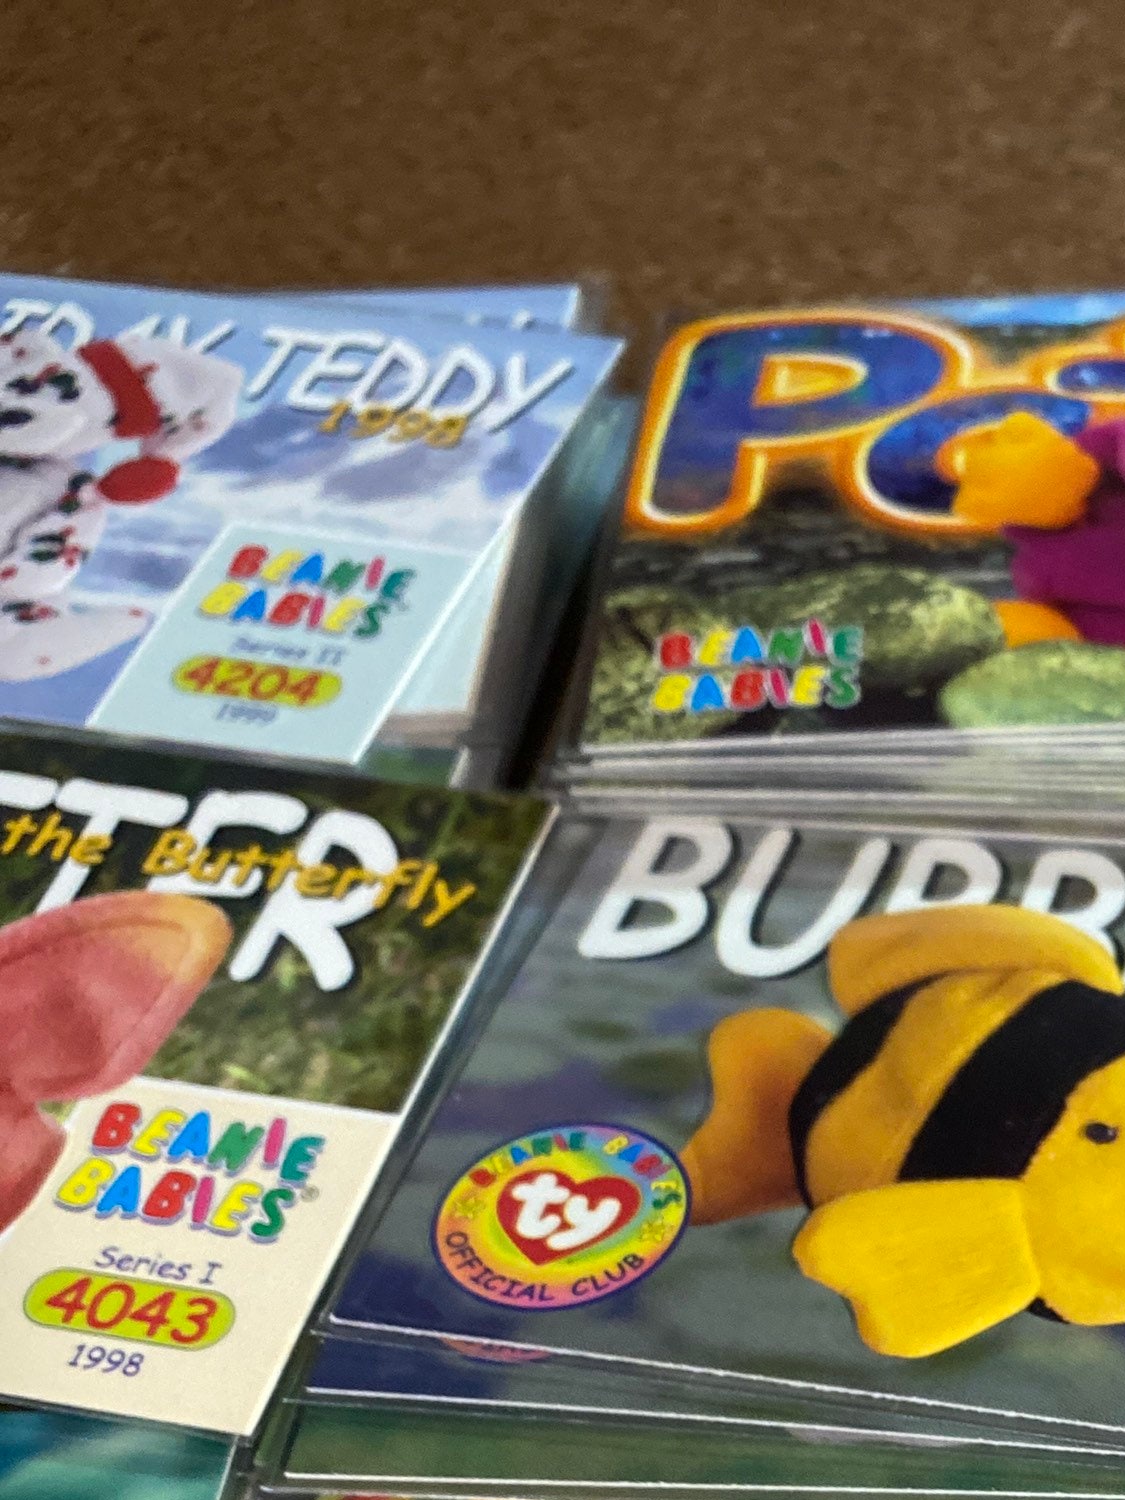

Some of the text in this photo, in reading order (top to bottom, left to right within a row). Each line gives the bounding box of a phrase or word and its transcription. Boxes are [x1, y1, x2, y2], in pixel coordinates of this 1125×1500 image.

[247, 328, 574, 432] TEDDY
[312, 402, 468, 448] 1998
[227, 543, 416, 600] BEANIE
[198, 580, 390, 638] BABIES
[655, 617, 865, 672] BEANIE
[182, 655, 322, 706] 4204
[650, 664, 862, 715] BABIES
[0, 772, 400, 992] TER
[2, 811, 477, 928] the Butterfly
[92, 1101, 326, 1188] BEANIE
[54, 1156, 296, 1244] BABIES
[511, 1172, 622, 1251] ty
[95, 1246, 223, 1286] Series I
[445, 1230, 646, 1301] OFFICIAL CLUB
[45, 1276, 218, 1344] 4043
[68, 1344, 145, 1377] 1998
